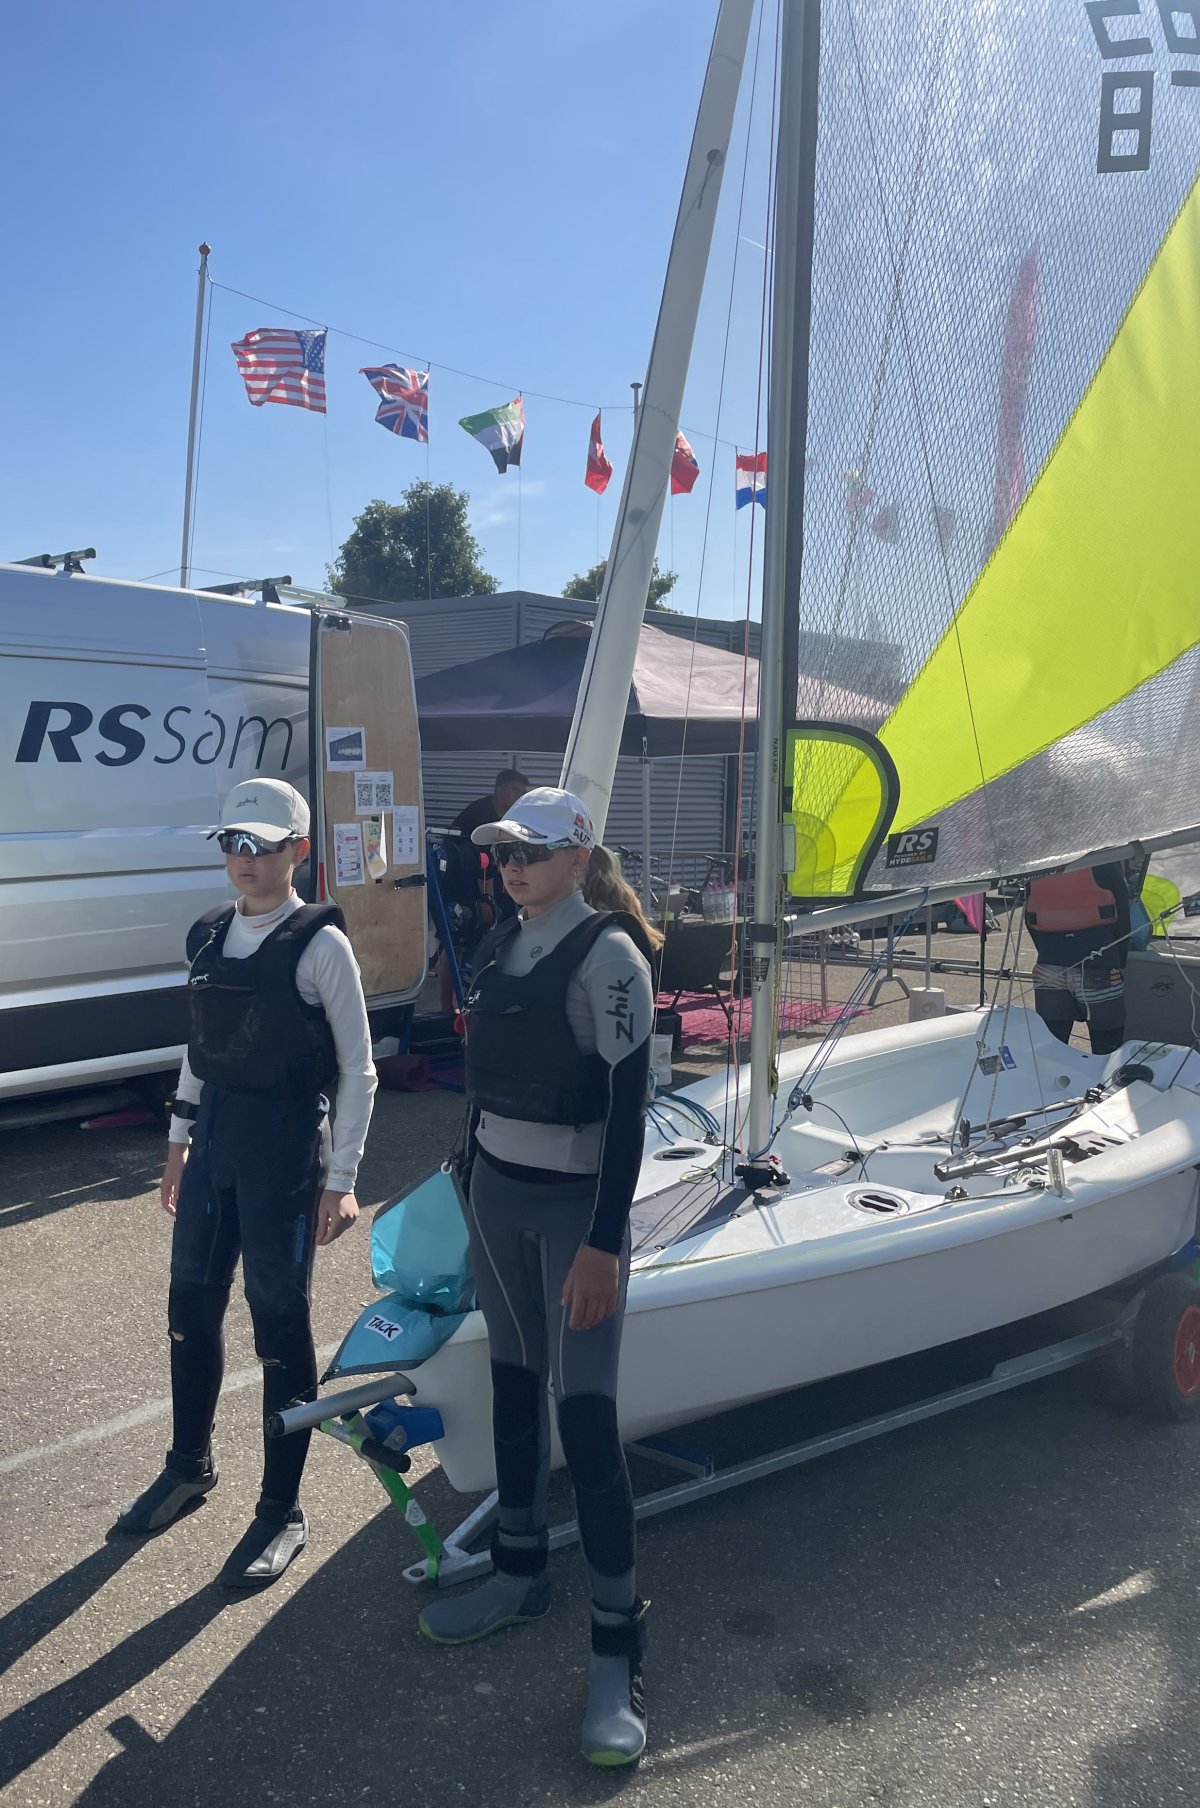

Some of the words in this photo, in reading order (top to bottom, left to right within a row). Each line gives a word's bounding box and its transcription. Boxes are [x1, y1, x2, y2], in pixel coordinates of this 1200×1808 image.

[896, 831, 934, 853] RS
[605, 975, 635, 1044] zhik
[368, 1316, 400, 1339] TACK
